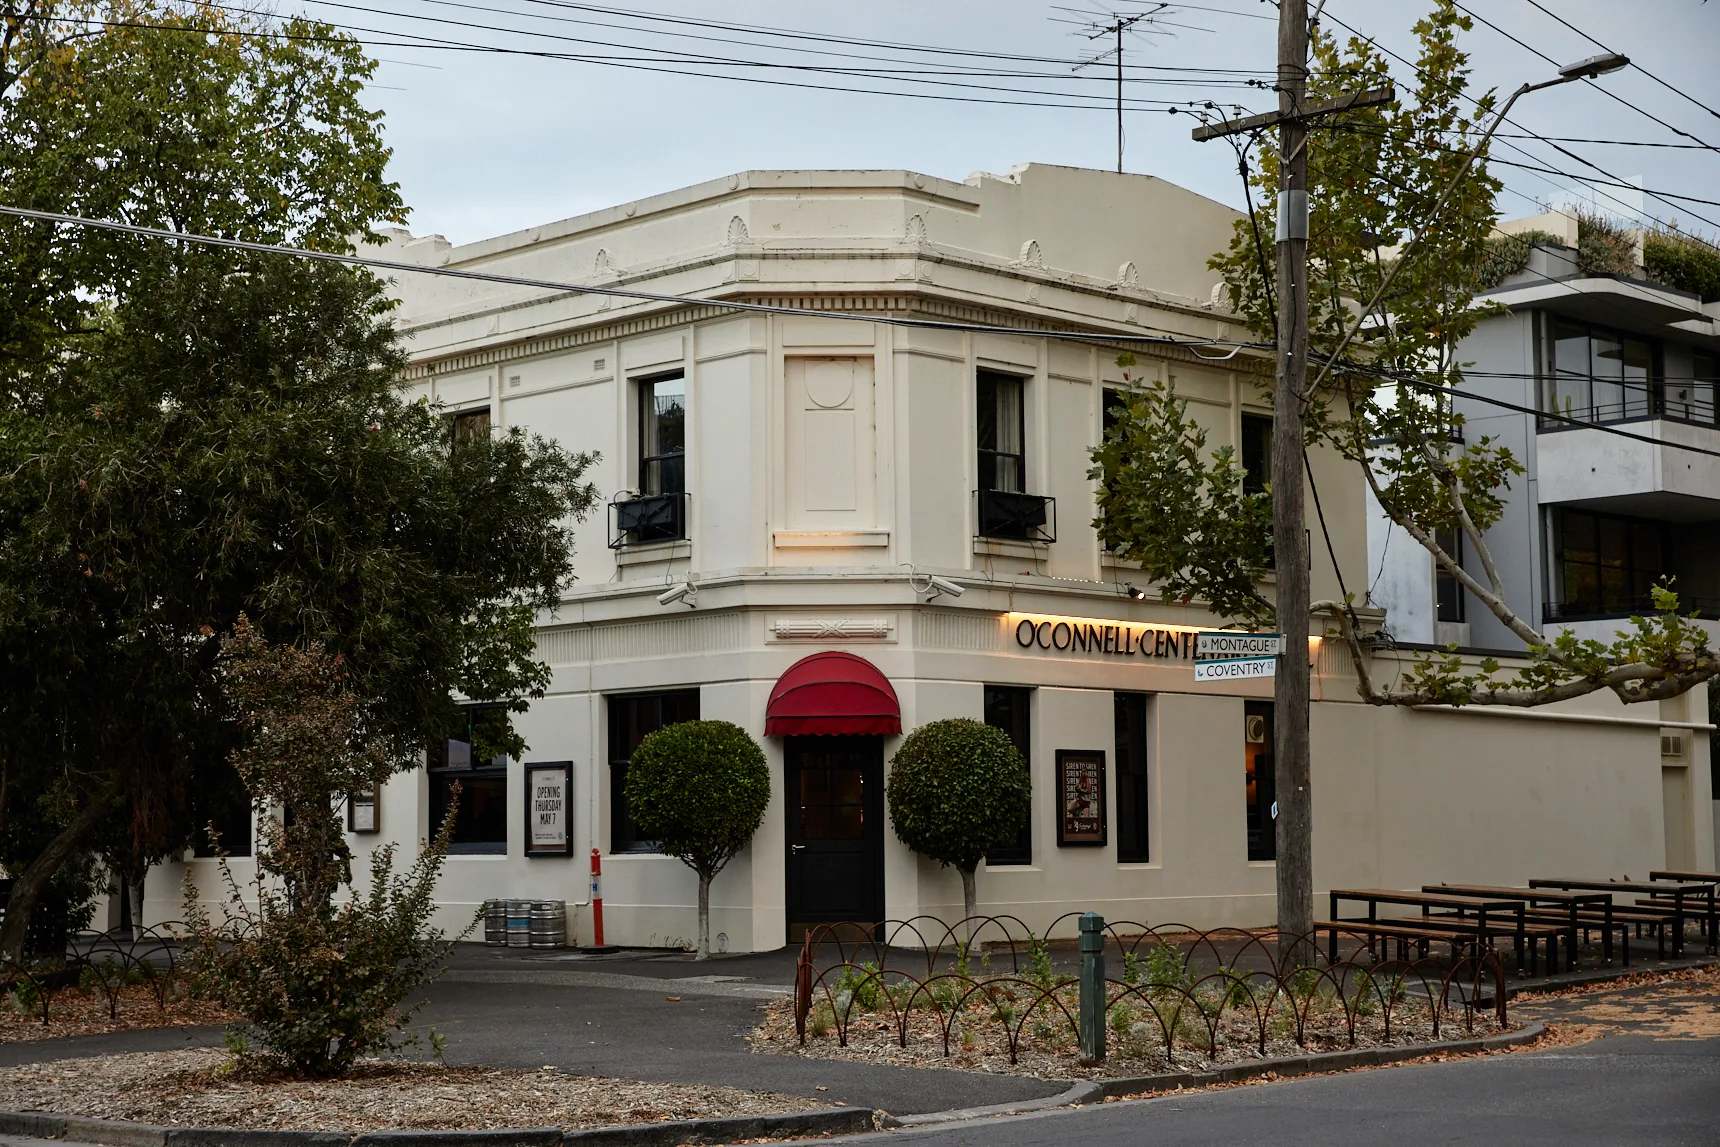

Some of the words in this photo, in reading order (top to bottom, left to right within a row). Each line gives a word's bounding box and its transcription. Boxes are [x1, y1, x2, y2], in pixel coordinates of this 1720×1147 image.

[1016, 619, 1135, 654] O'CONNELL
[1210, 638, 1270, 652] MONTAGUE
[1206, 662, 1266, 677] COVENTRY
[537, 786, 561, 799] OPENING
[535, 800, 562, 812] THURSDAY
[540, 813, 552, 825] MAY
[552, 813, 556, 825] 7
